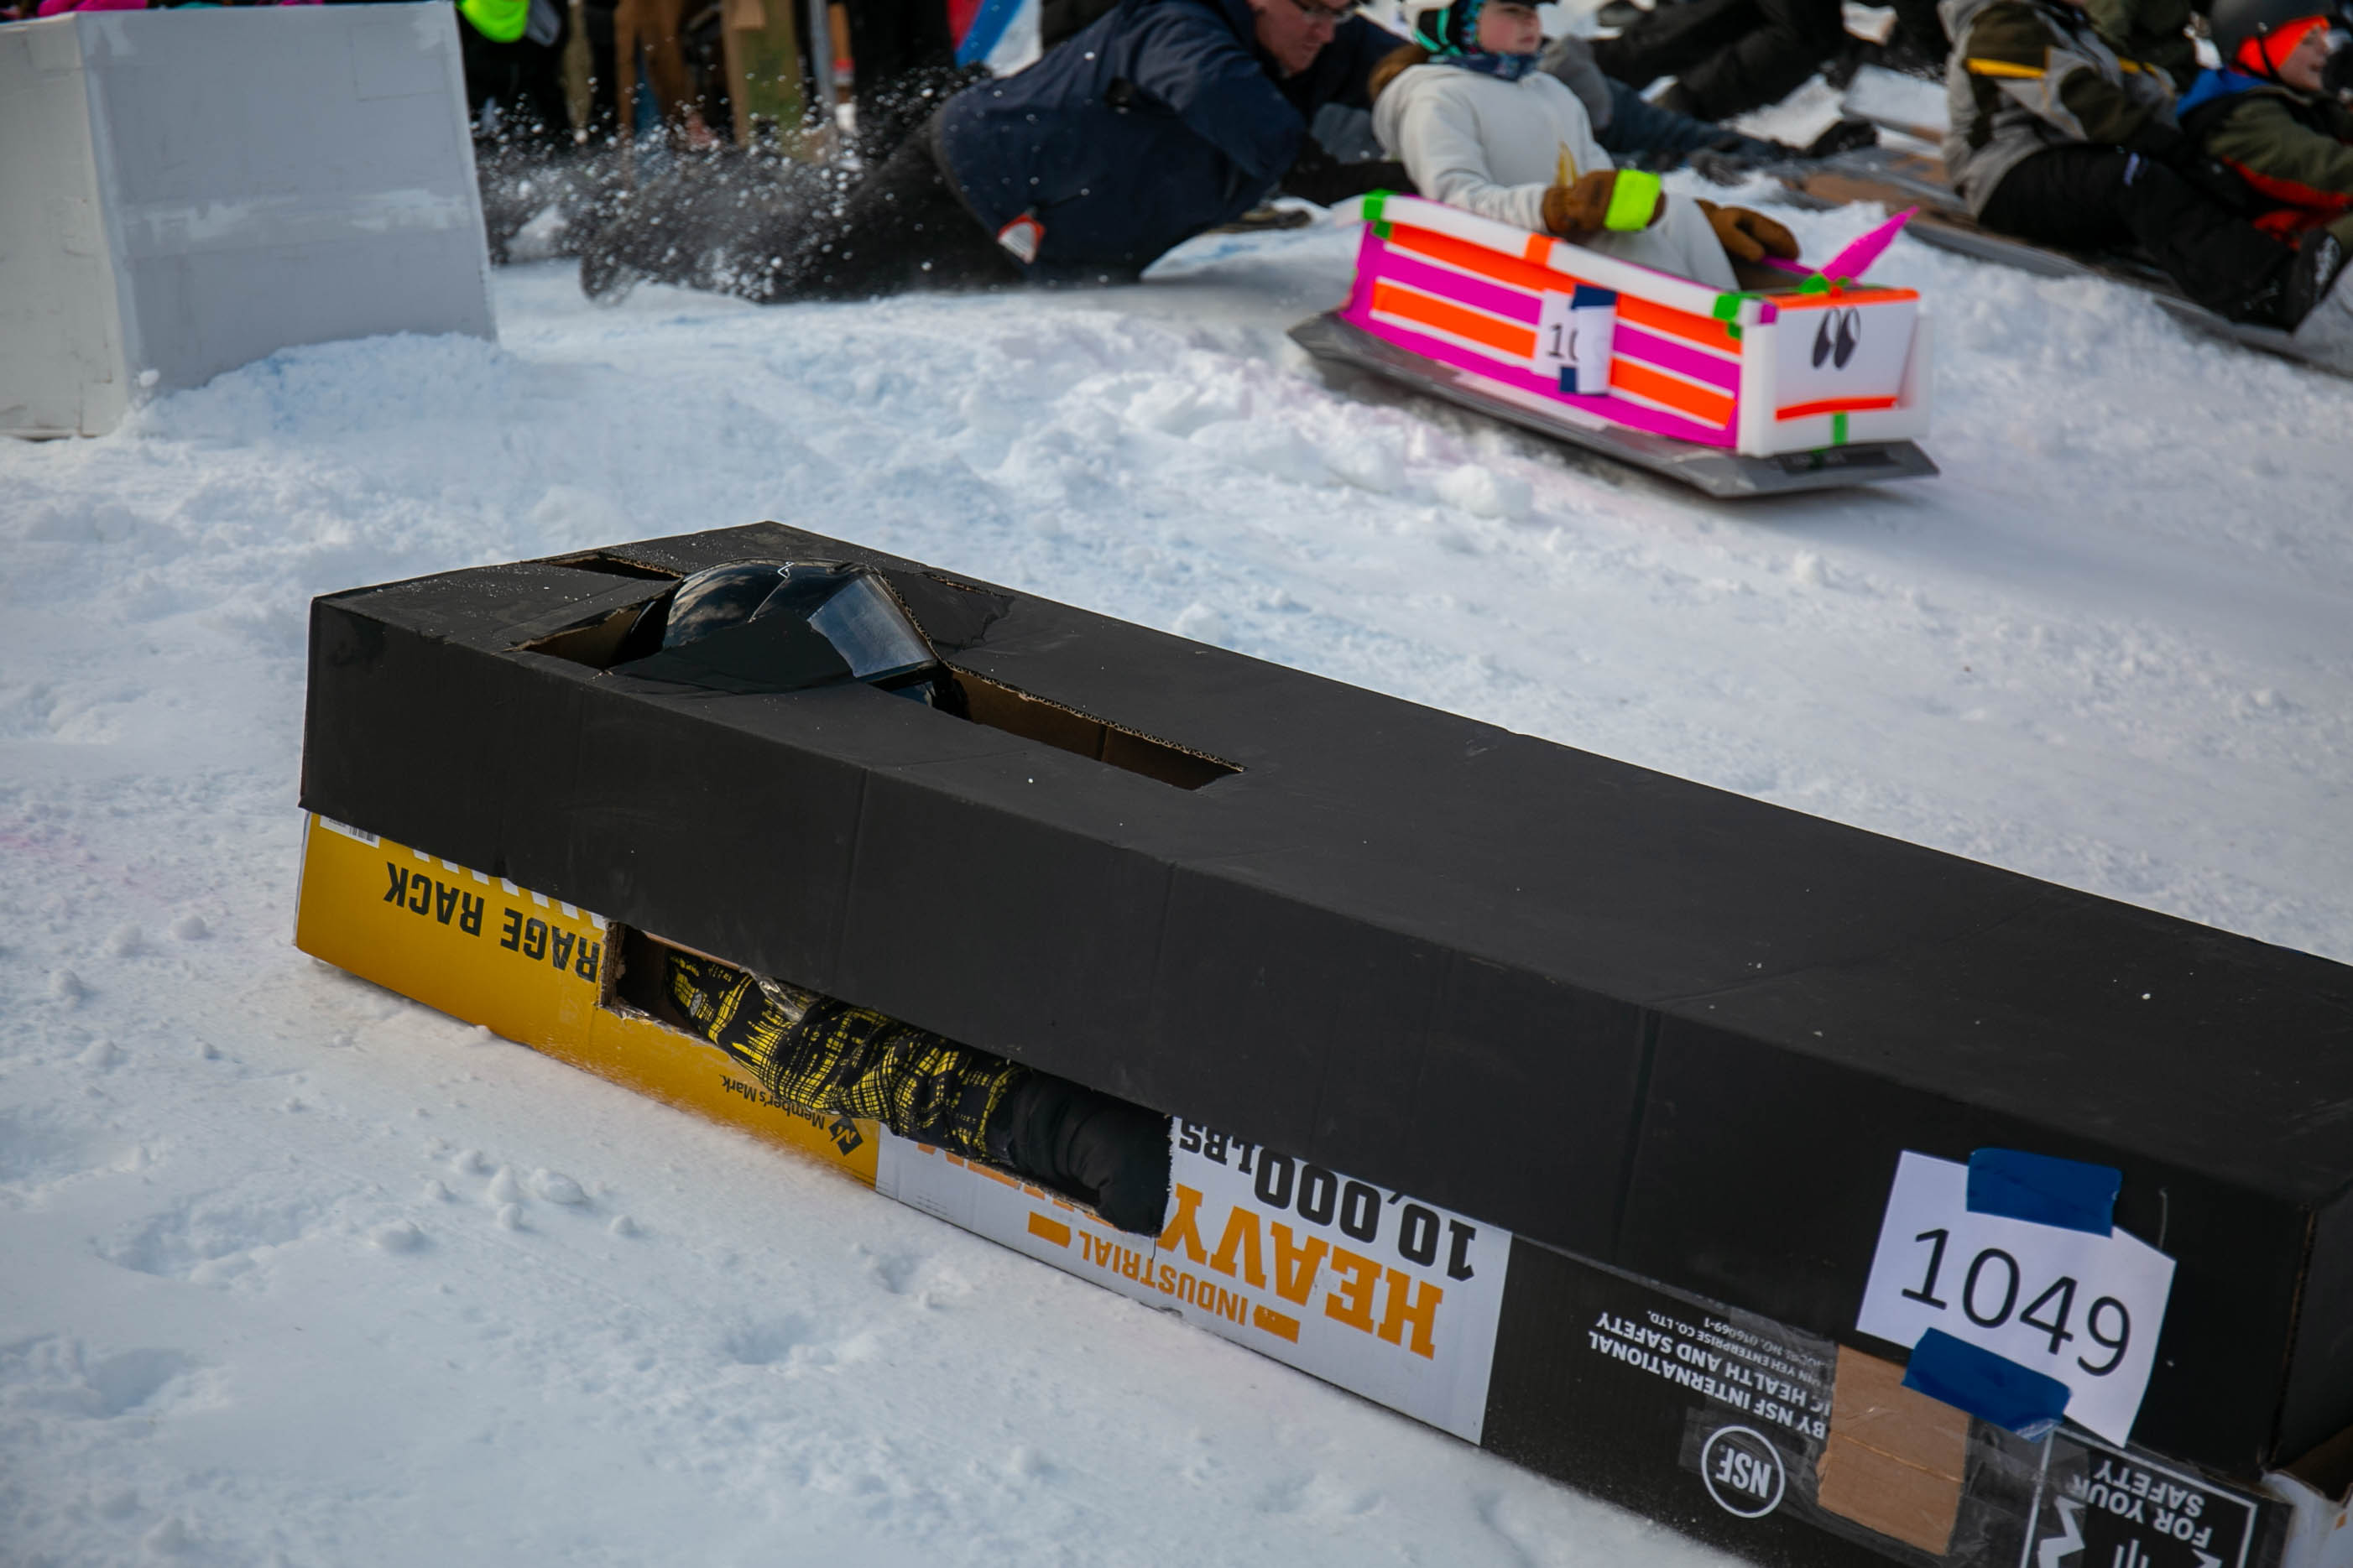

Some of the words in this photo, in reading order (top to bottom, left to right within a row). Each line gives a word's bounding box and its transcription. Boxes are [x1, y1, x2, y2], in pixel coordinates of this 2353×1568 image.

[383, 862, 484, 937] RACK
[500, 907, 602, 982] RAGE
[759, 1091, 825, 1130] Member's
[1078, 1230, 1247, 1326] INDUSTRIAL
[1156, 1182, 1443, 1361] HEAVY
[1901, 1228, 2131, 1378] 1049
[1596, 1311, 1674, 1354] SAFETY
[1697, 1331, 1770, 1367] ENTERPRISE
[1588, 1331, 1751, 1410] INTERNATIONAL
[1677, 1344, 1723, 1372] AND
[1725, 1362, 1807, 1407] HEALTH
[1753, 1399, 1794, 1426] NSF
[1797, 1415, 1827, 1440] BY
[1715, 1447, 1772, 1498] NSF
[2093, 1459, 2206, 1519] SAFETY
[2066, 1474, 2145, 1524] YOUR
[2153, 1508, 2213, 1550] FOR
